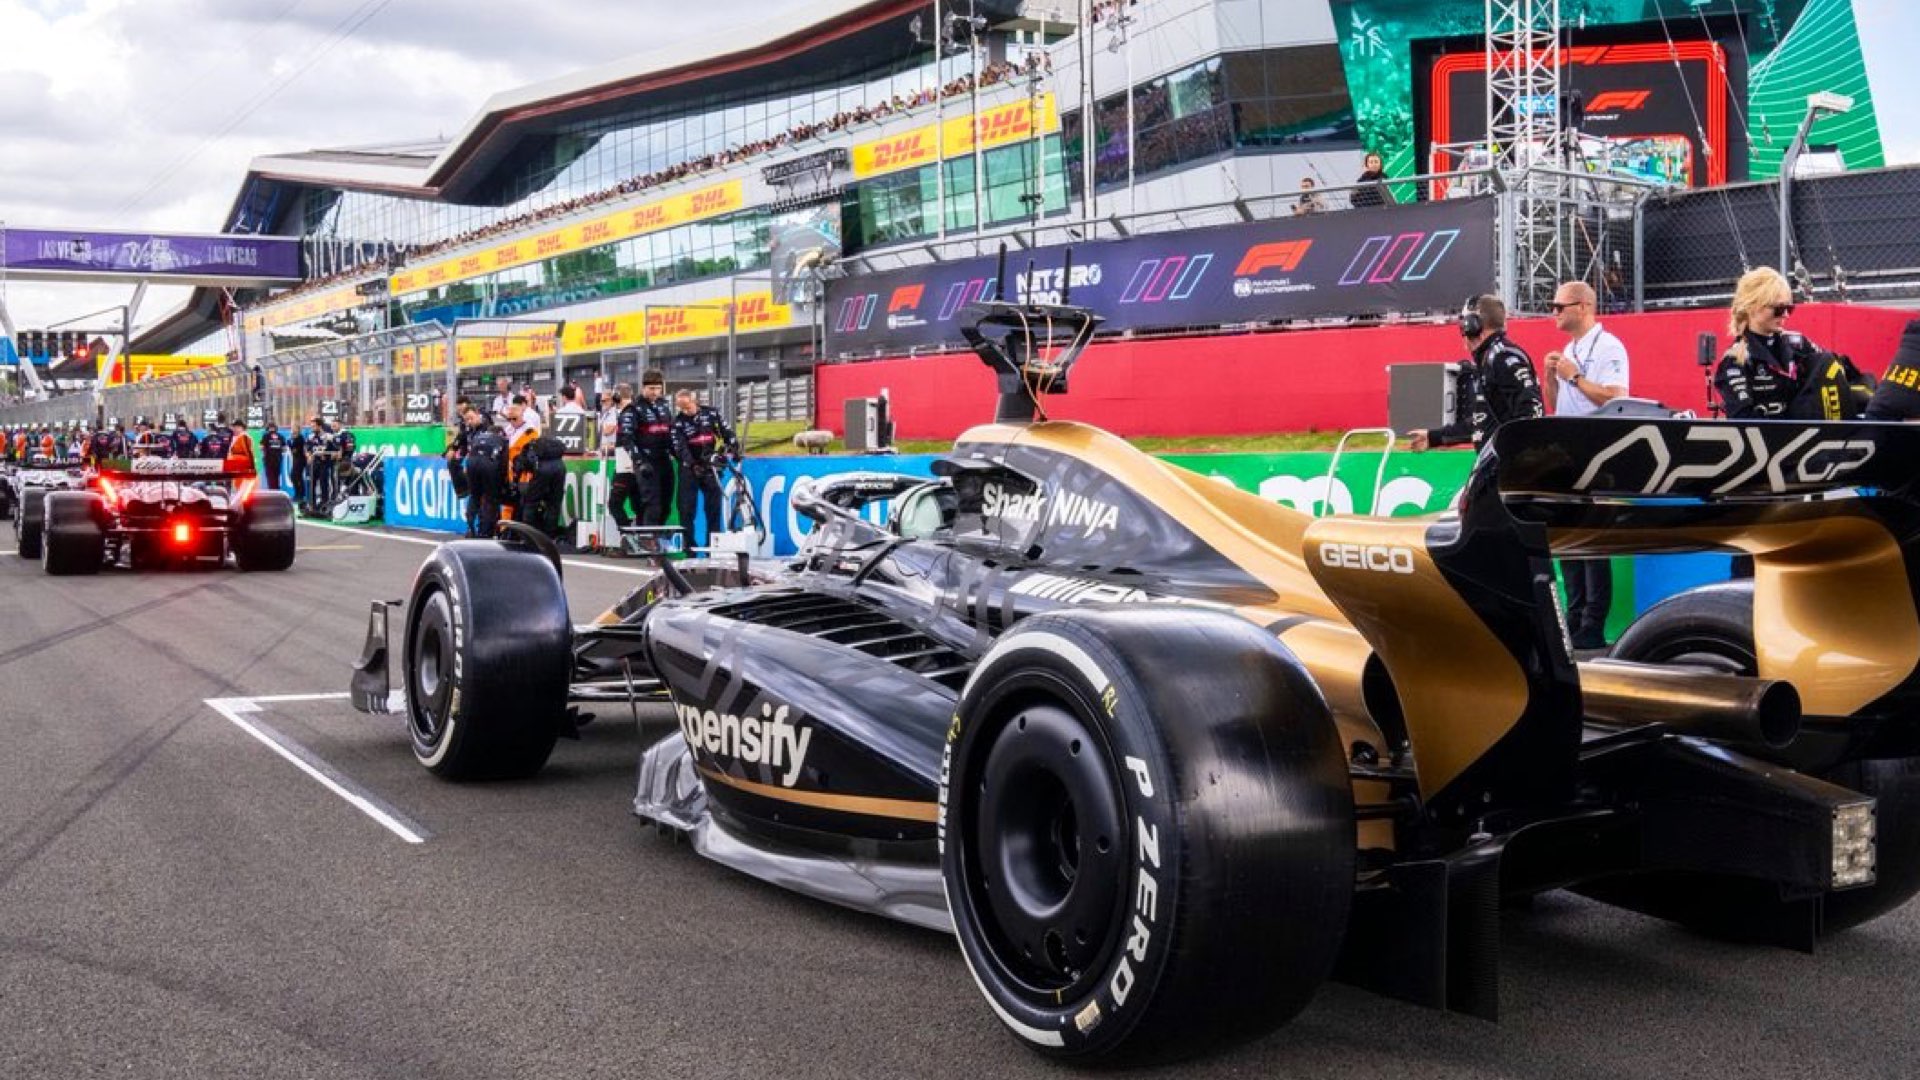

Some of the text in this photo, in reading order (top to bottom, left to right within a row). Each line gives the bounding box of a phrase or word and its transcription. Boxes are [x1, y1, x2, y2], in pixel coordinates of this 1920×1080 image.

[874, 134, 925, 168] DHL
[691, 188, 727, 213] DHL
[633, 206, 666, 228] DHL
[582, 221, 612, 243] DHL
[38, 239, 57, 259] LAS
[208, 245, 257, 266] LAS VEGAS
[1016, 263, 1102, 293] NET ZERO
[583, 321, 619, 345] DHL
[648, 309, 689, 336] DHL
[321, 401, 338, 414] 21
[406, 394, 429, 408] 20
[406, 412, 431, 422] MAG
[554, 414, 580, 432] 77
[982, 482, 1119, 539] Shark NINJA
[1319, 543, 1415, 574] GEICO
[675, 702, 813, 787] xpensify
[1110, 756, 1160, 1007] P ZERO
